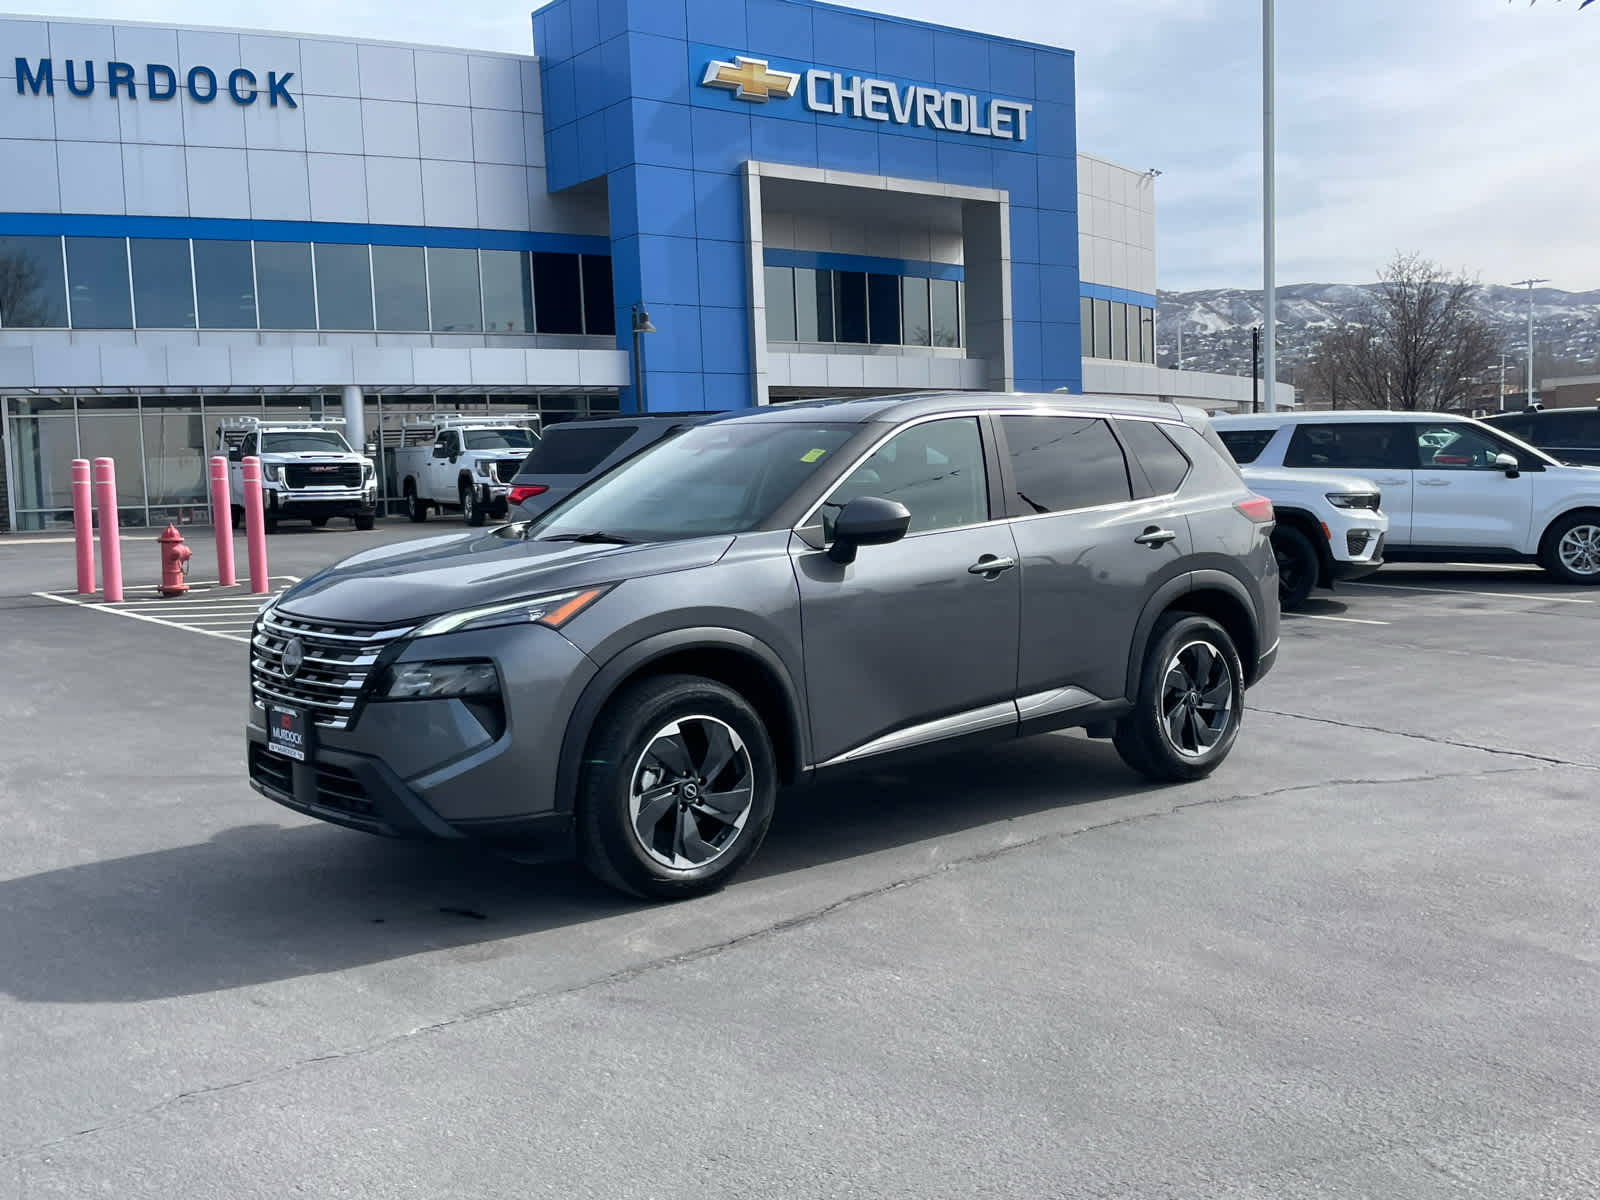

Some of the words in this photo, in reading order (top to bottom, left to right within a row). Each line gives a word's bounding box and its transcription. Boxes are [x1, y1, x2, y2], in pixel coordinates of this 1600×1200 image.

[15, 57, 298, 109] MURDOCK
[805, 68, 1033, 141] CHEVROLET
[309, 464, 340, 473] GMC
[272, 727, 303, 745] MURDOCK
